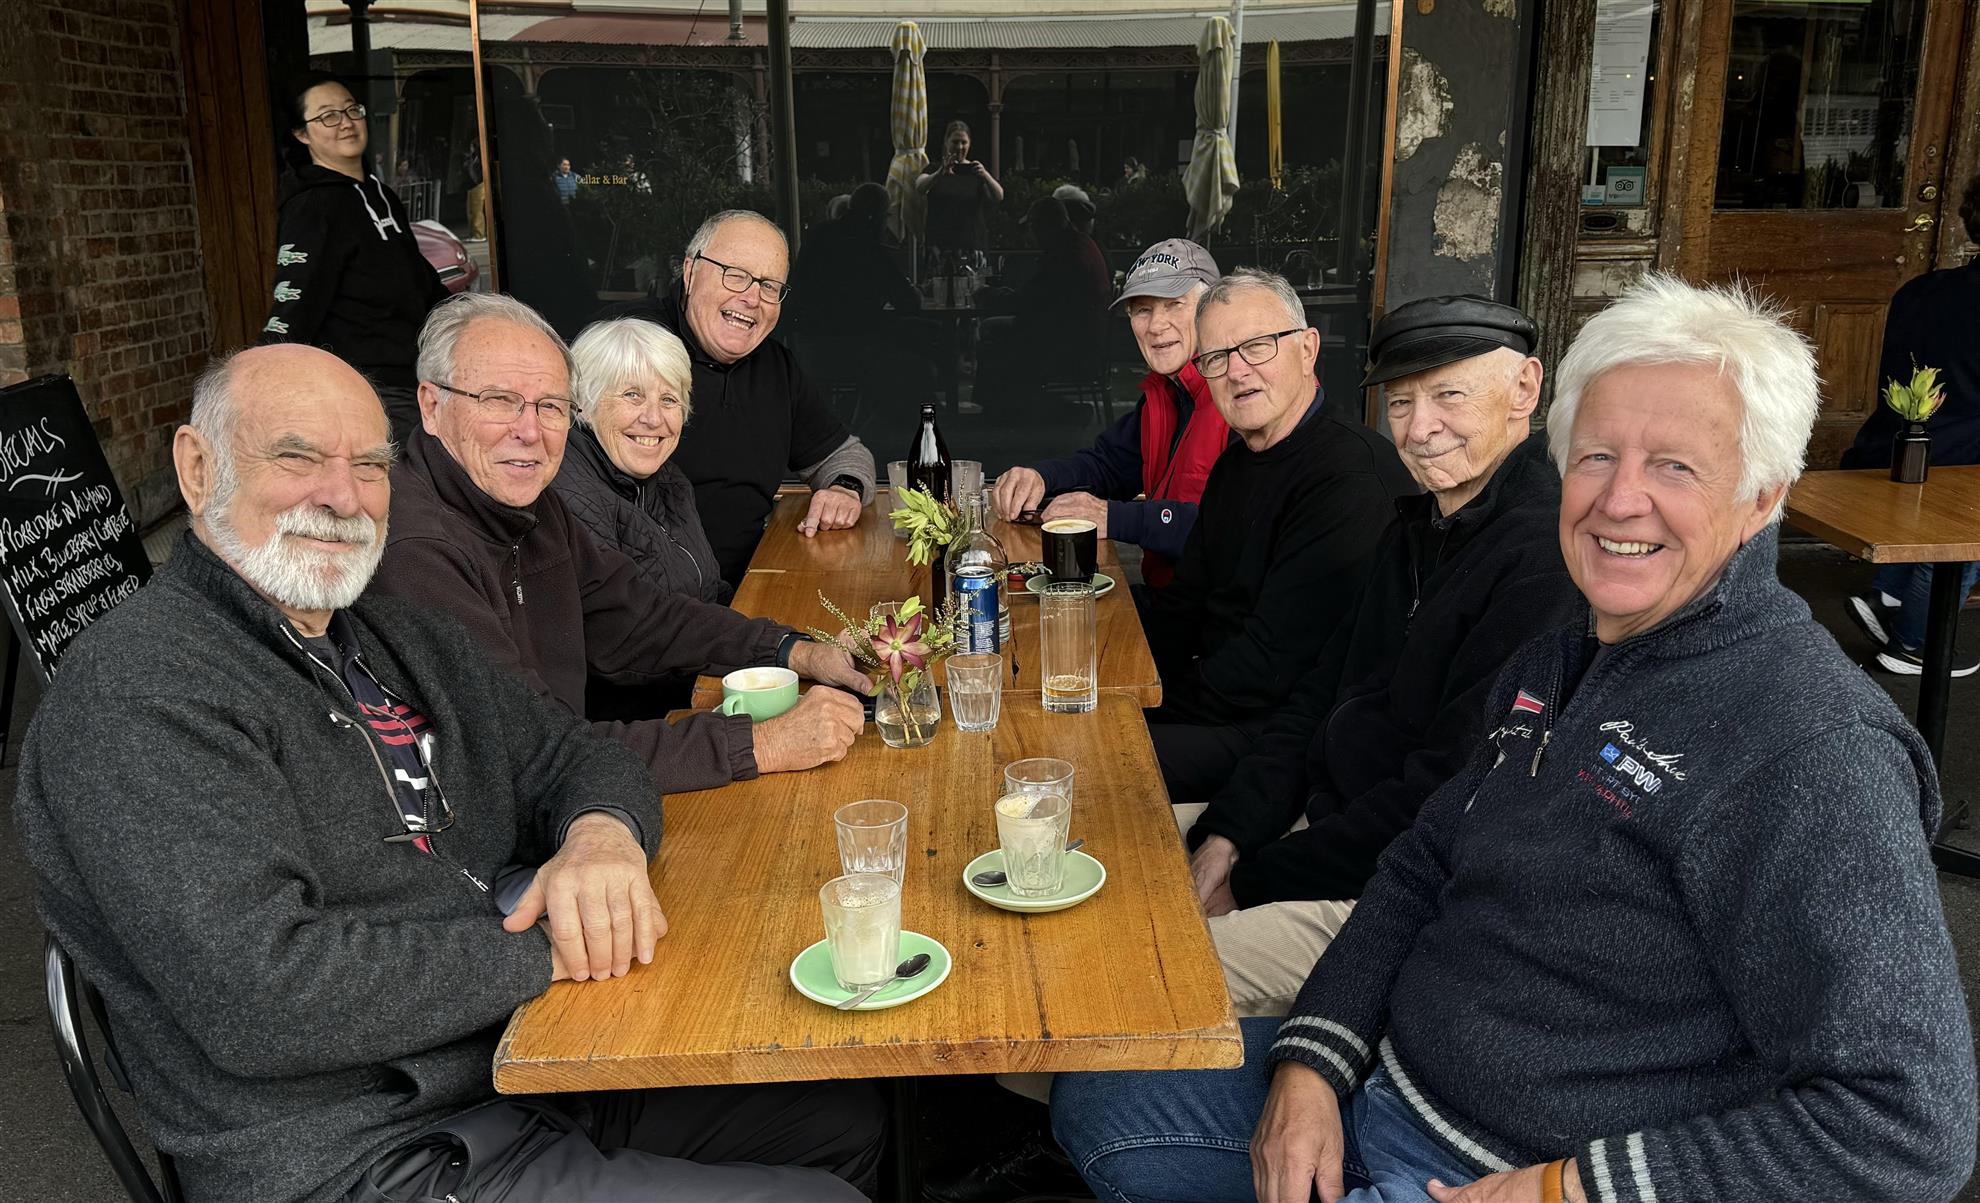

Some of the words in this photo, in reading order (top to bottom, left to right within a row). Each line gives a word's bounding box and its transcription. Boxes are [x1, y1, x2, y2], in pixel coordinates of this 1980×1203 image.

[575, 174, 601, 185] Cellar
[602, 175, 611, 185] &
[612, 174, 628, 185] Bar
[1150, 252, 1181, 273] YORK
[0, 417, 66, 483] PECIALS
[2, 502, 63, 553] PORRIDGE
[70, 484, 112, 520] ALMOND
[10, 556, 50, 594] MILK,
[40, 526, 102, 574] BLUEBERRY
[25, 587, 60, 621] FRESH
[36, 618, 73, 656] MAPLE
[65, 594, 99, 633] SYRUP
